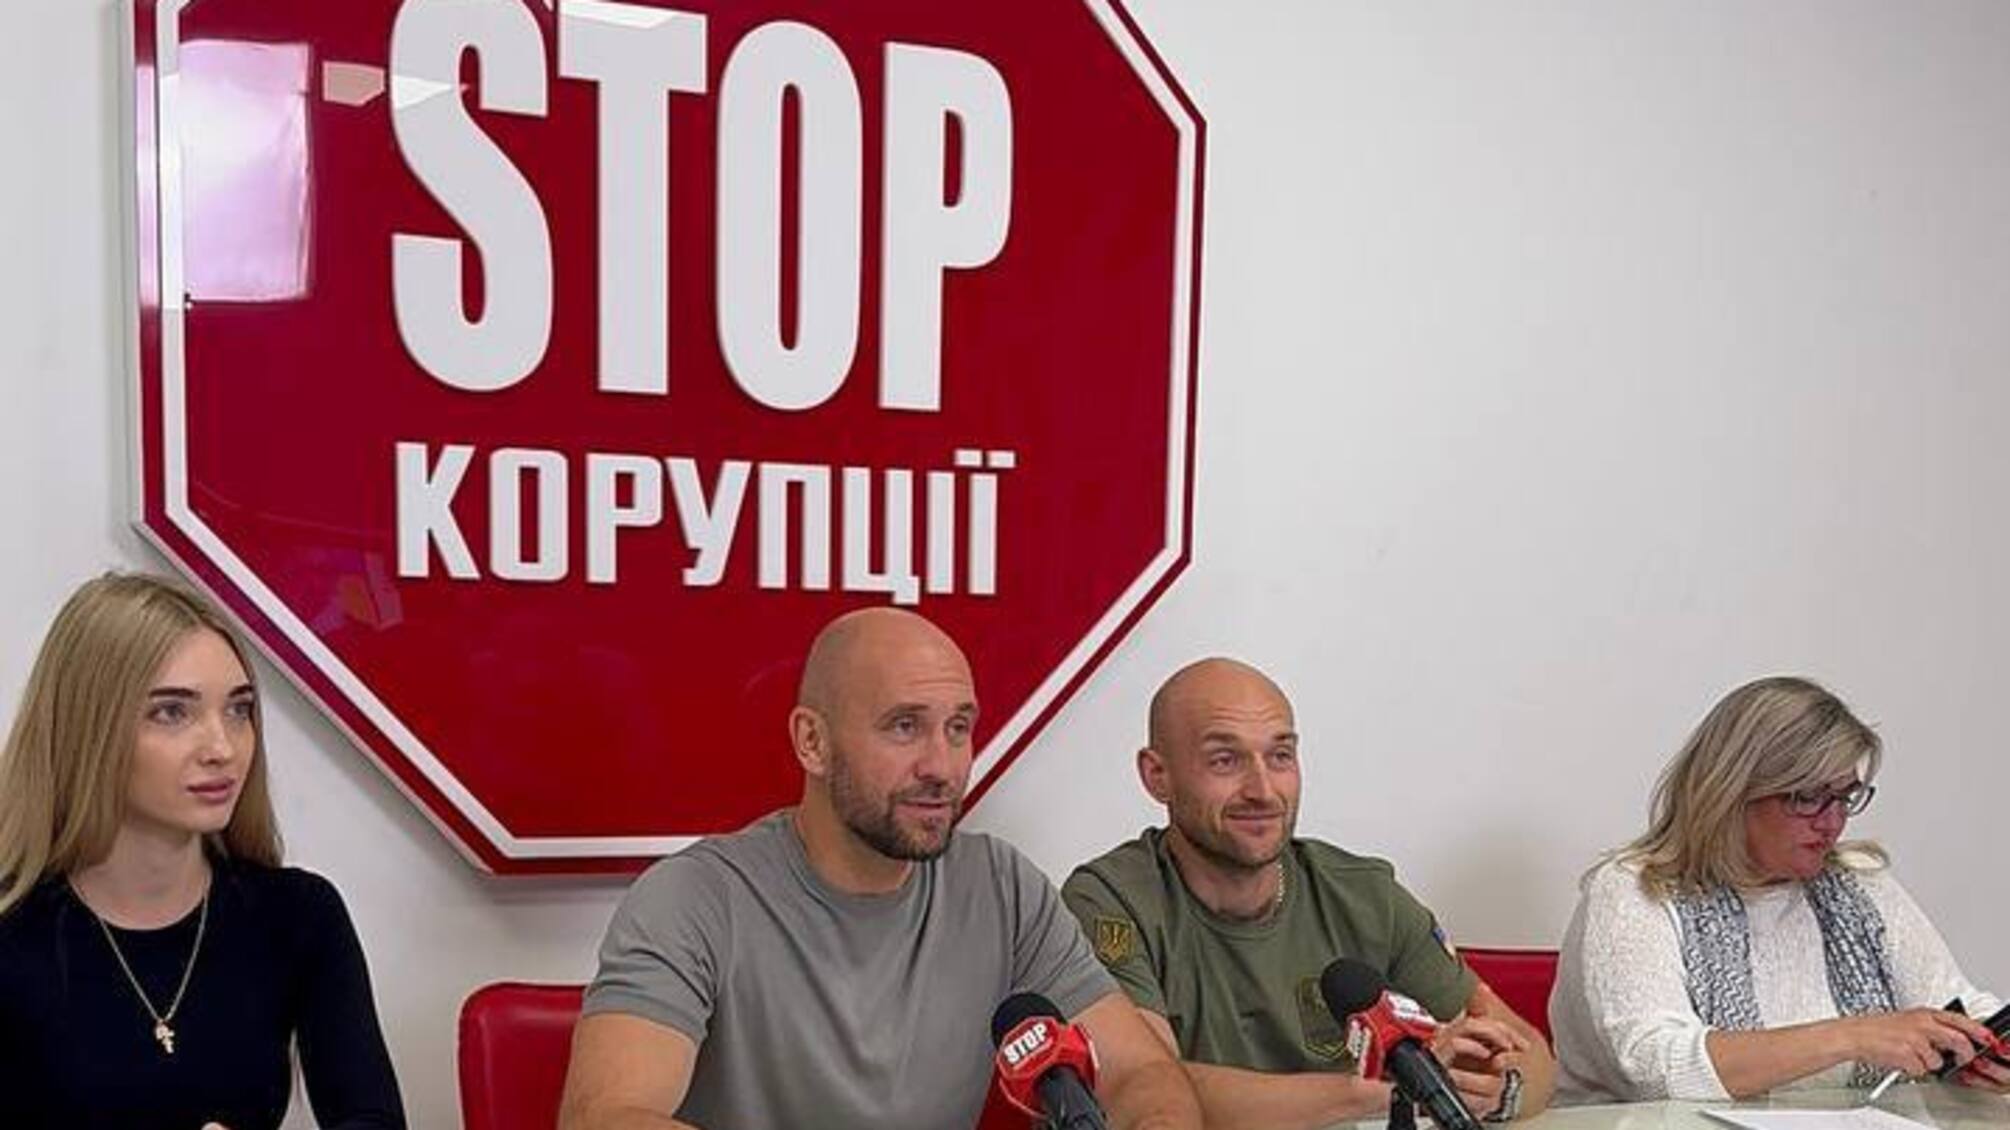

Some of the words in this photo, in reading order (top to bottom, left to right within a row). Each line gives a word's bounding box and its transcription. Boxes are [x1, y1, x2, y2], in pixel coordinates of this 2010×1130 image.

[389, 0, 1014, 412] STOP
[394, 441, 1017, 605] КОРУПЦІЇ
[1003, 1022, 1048, 1064] STOP
